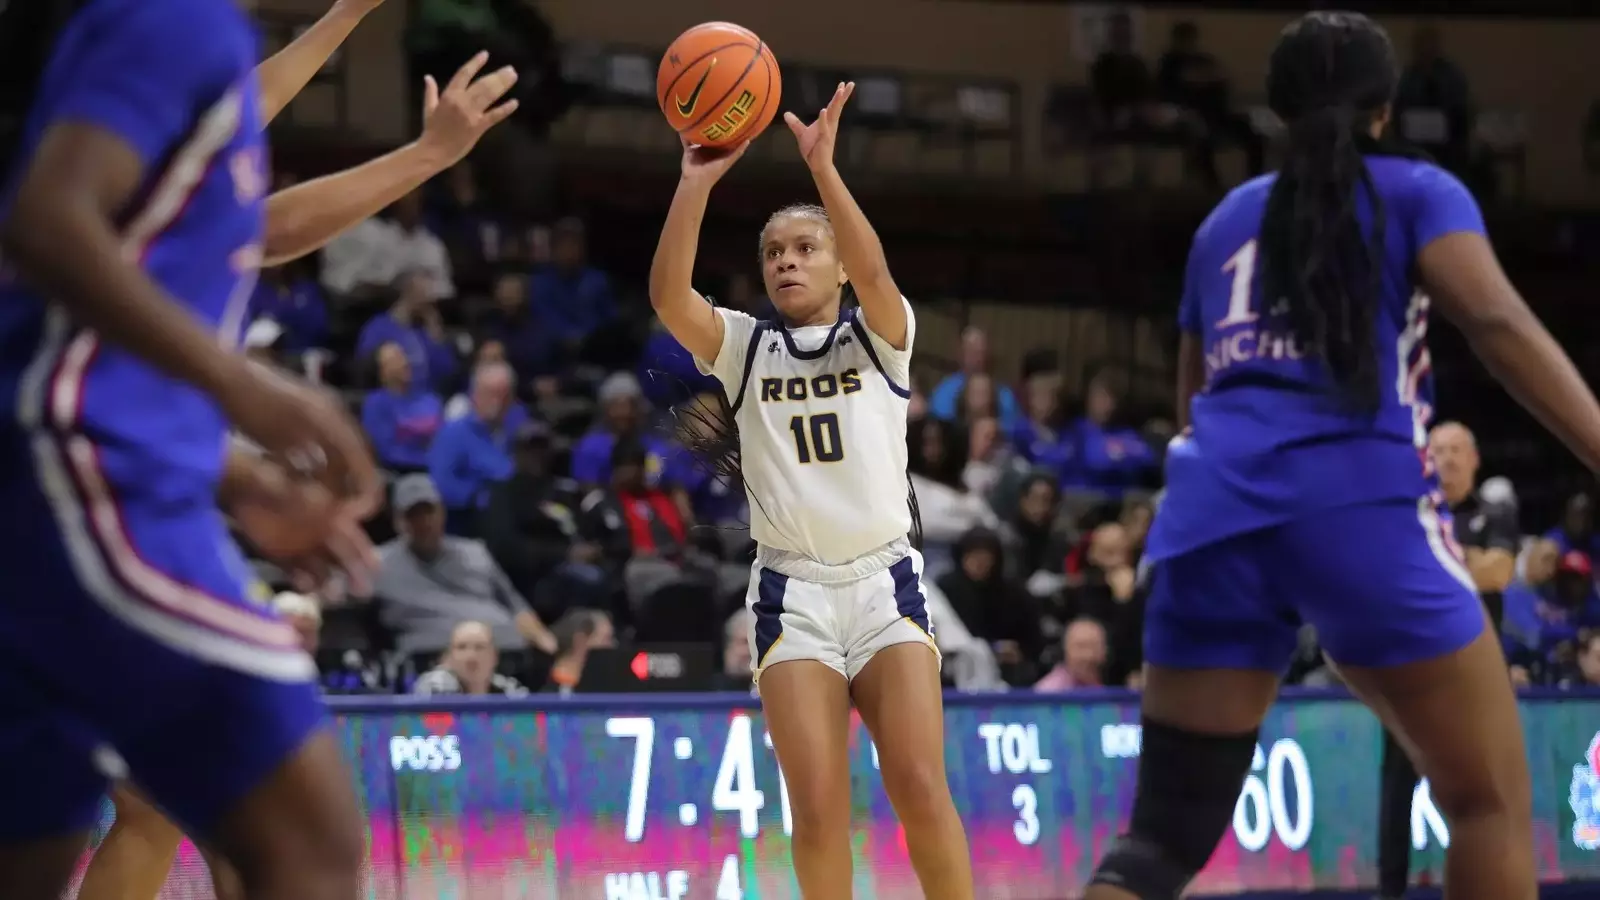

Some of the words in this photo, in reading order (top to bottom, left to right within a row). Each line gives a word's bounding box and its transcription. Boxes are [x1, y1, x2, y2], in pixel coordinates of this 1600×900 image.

[701, 88, 758, 142] ELITE
[760, 368, 863, 403] ROOS
[788, 411, 844, 465] 10
[389, 734, 462, 770] POSS
[977, 722, 1052, 775] TOL
[1011, 783, 1040, 846] 3
